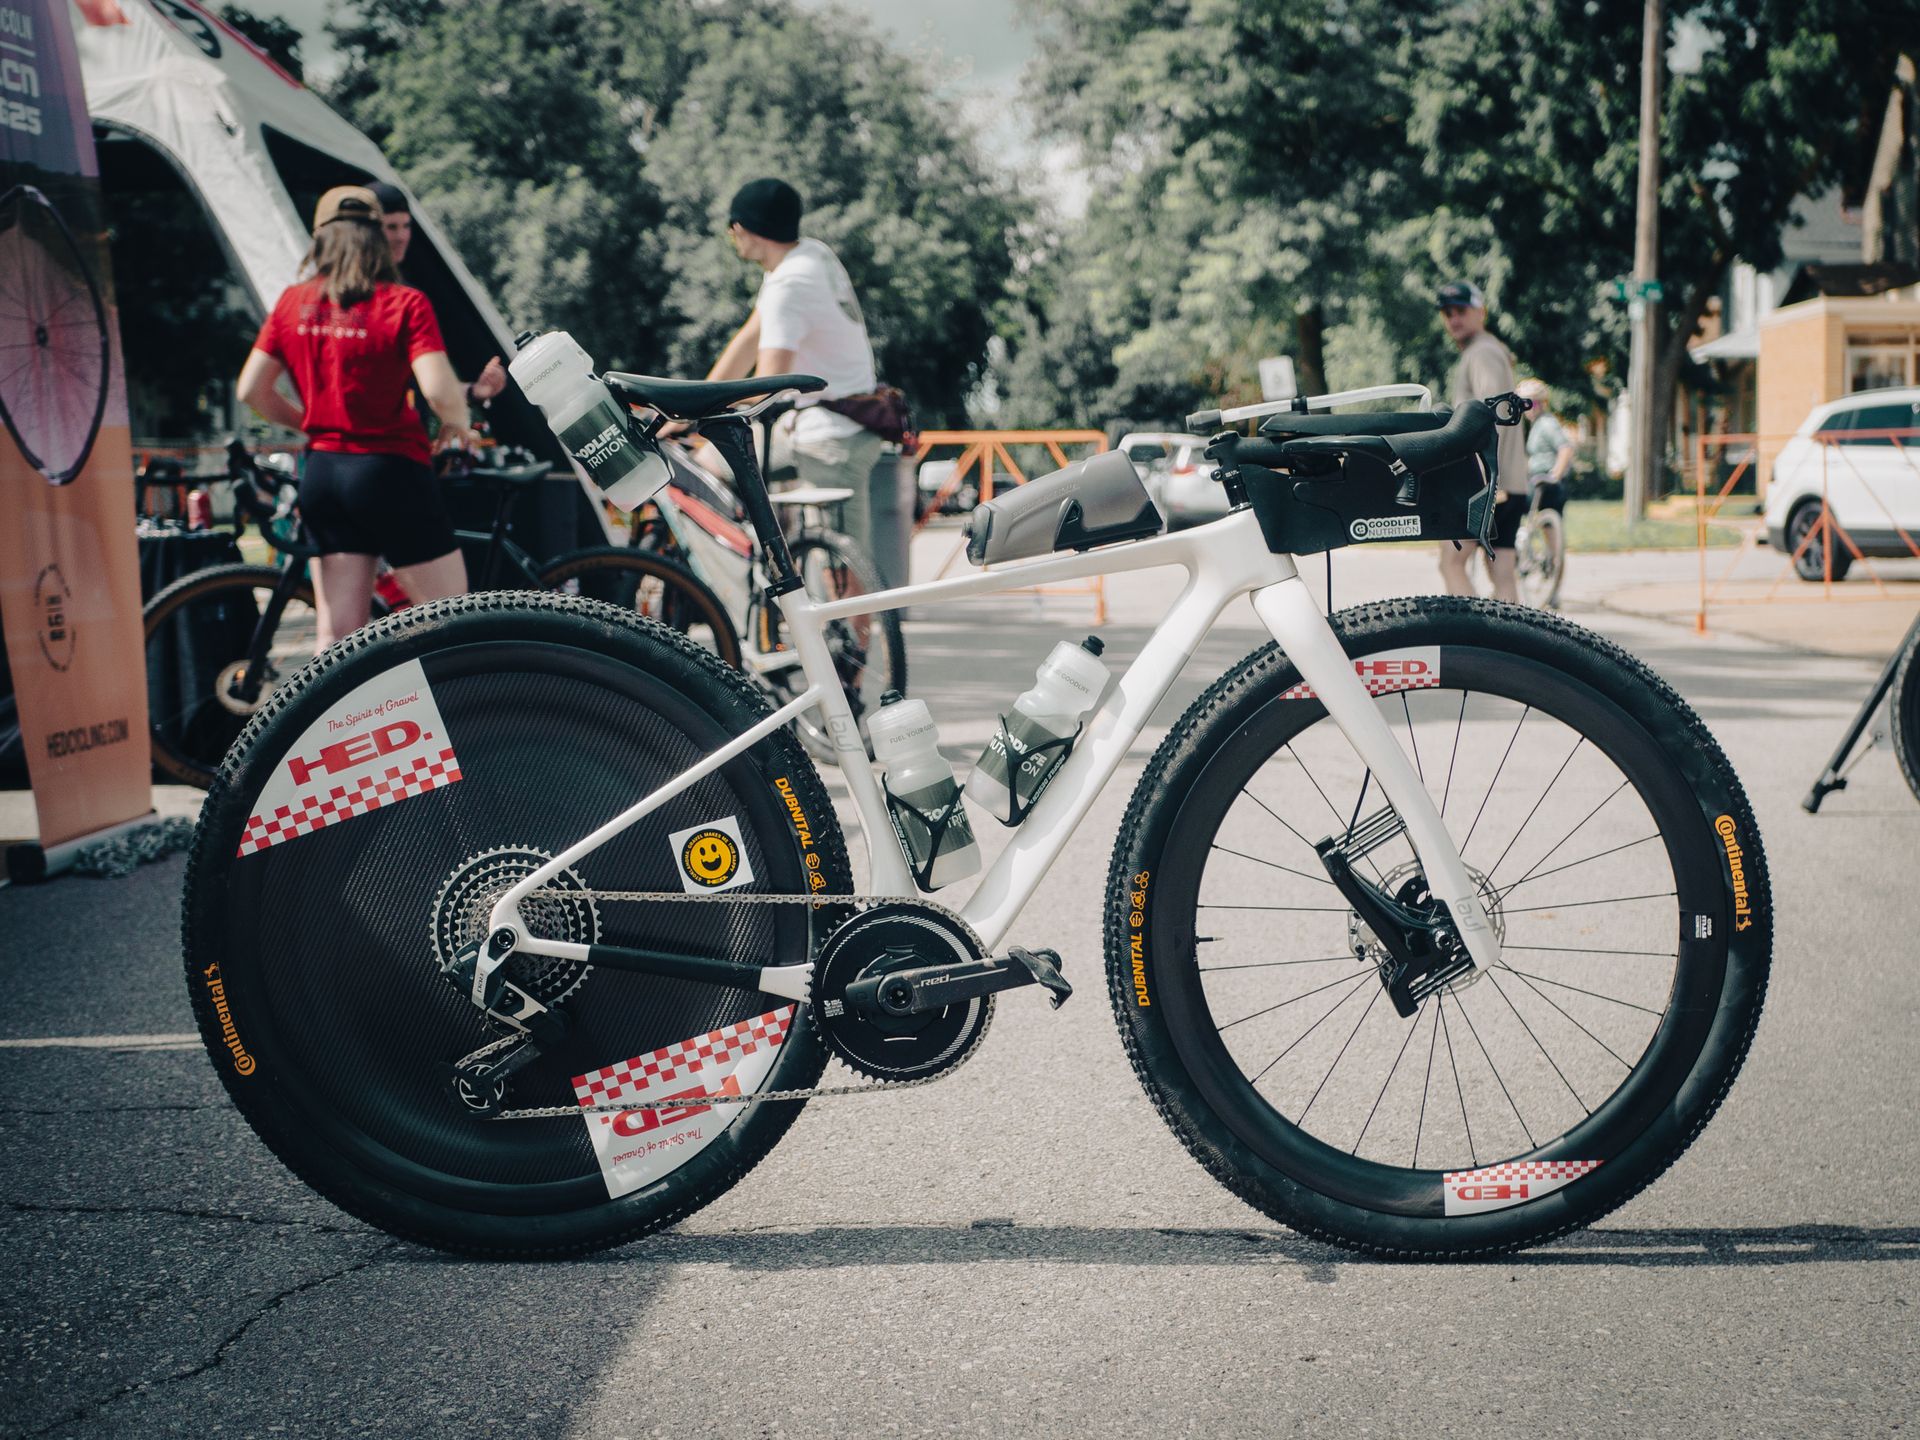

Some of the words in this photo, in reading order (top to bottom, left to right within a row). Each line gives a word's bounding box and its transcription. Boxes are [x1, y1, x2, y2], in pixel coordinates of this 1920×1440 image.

[587, 433, 629, 469] TRITION
[1368, 518, 1419, 528] GOODLIFE
[1368, 526, 1419, 537] NUTRITION
[327, 720, 345, 733] The
[345, 707, 373, 726] Spirit
[374, 703, 385, 716] of
[385, 691, 420, 711] Gravel
[287, 720, 433, 786] HED.
[774, 777, 814, 850] DUBNITAL
[1715, 814, 1752, 914] Continental
[1130, 932, 1151, 1007] DUBNITAL
[206, 977, 256, 1076] Continental
[646, 1141, 657, 1154] of
[659, 1131, 685, 1149] Spirit
[687, 1127, 703, 1140] The
[612, 1146, 646, 1166] Gravel
